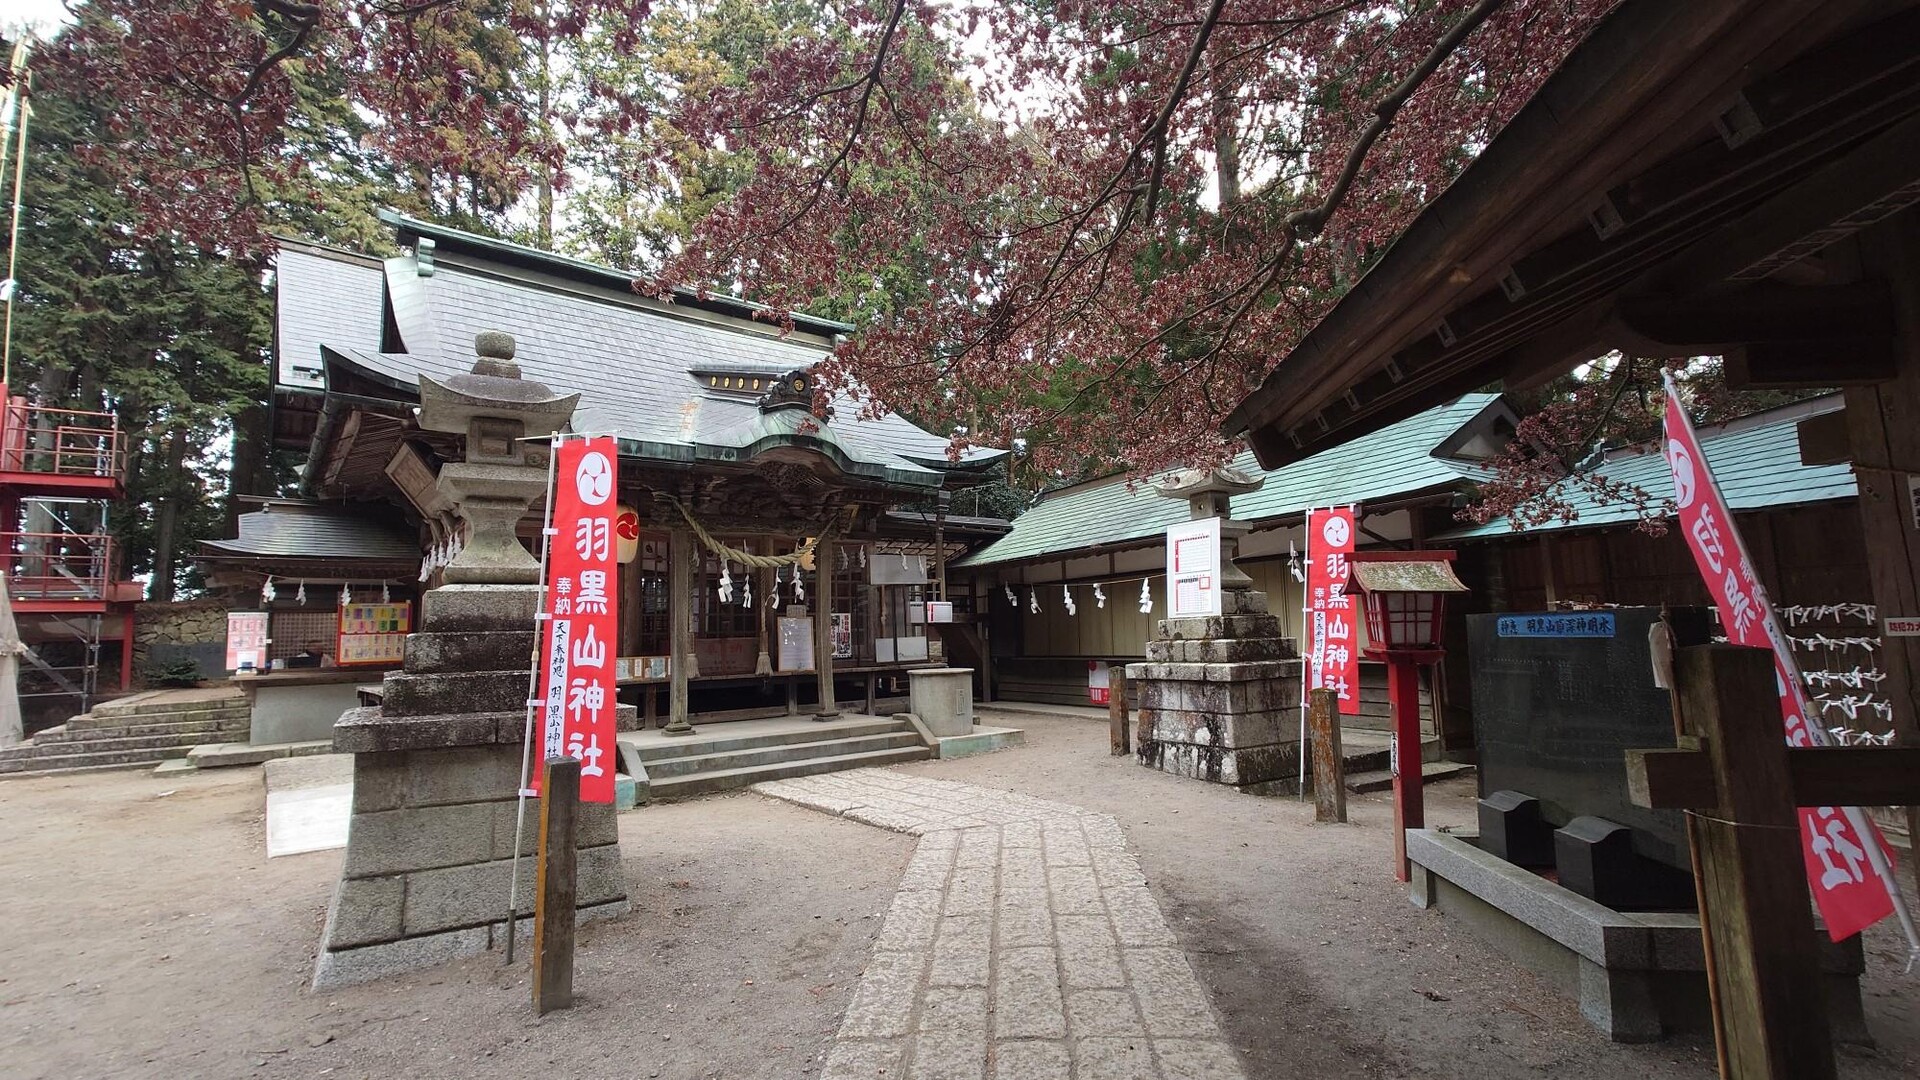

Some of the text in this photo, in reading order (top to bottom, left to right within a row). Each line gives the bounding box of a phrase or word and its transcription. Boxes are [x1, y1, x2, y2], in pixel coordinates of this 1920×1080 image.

[554, 577, 572, 615] 奉納
[1314, 587, 1325, 609] 奉納
[1324, 553, 1350, 700] 羽黒山神社
[568, 517, 609, 777] 羽黒山神社
